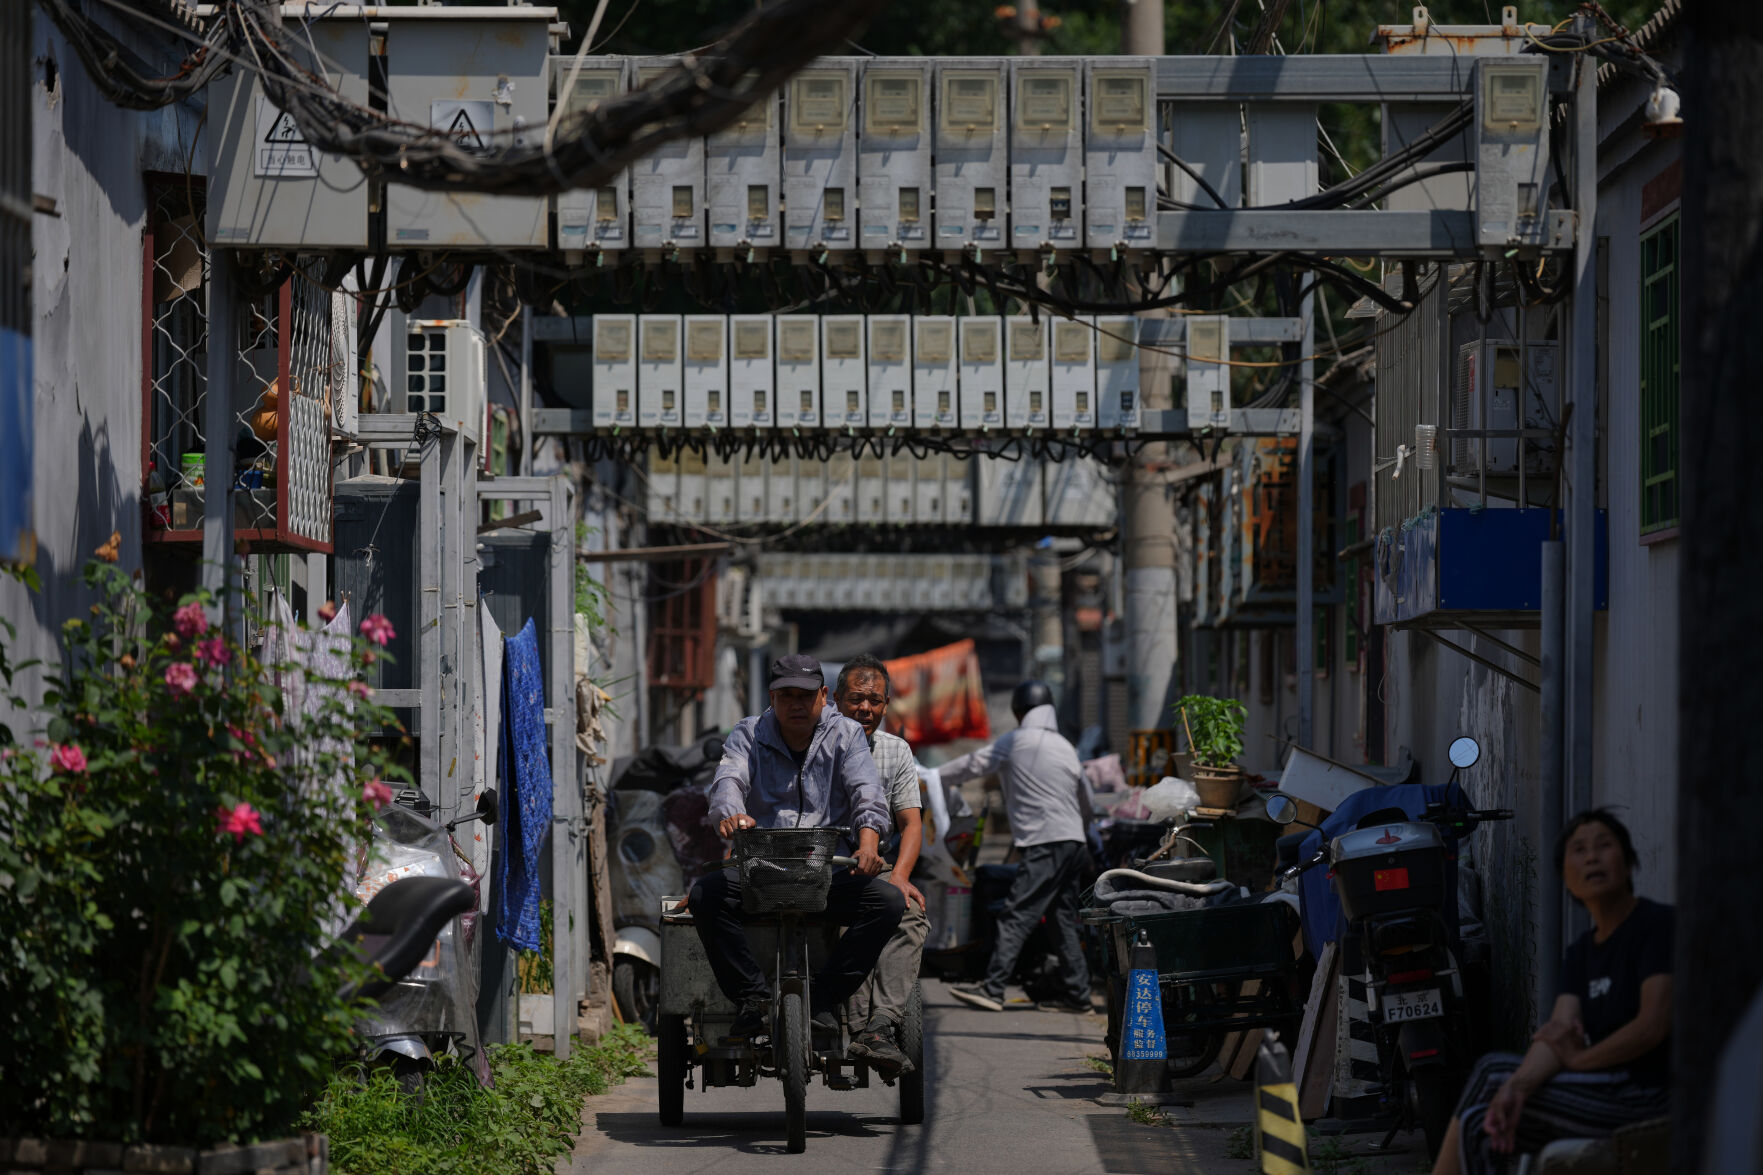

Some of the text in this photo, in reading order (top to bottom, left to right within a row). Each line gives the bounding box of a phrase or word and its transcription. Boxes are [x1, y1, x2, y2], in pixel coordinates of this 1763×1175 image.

[1136, 973, 1153, 1028] 安达停车
[1395, 993, 1429, 1006] 北京
[1388, 1000, 1439, 1020] F70624
